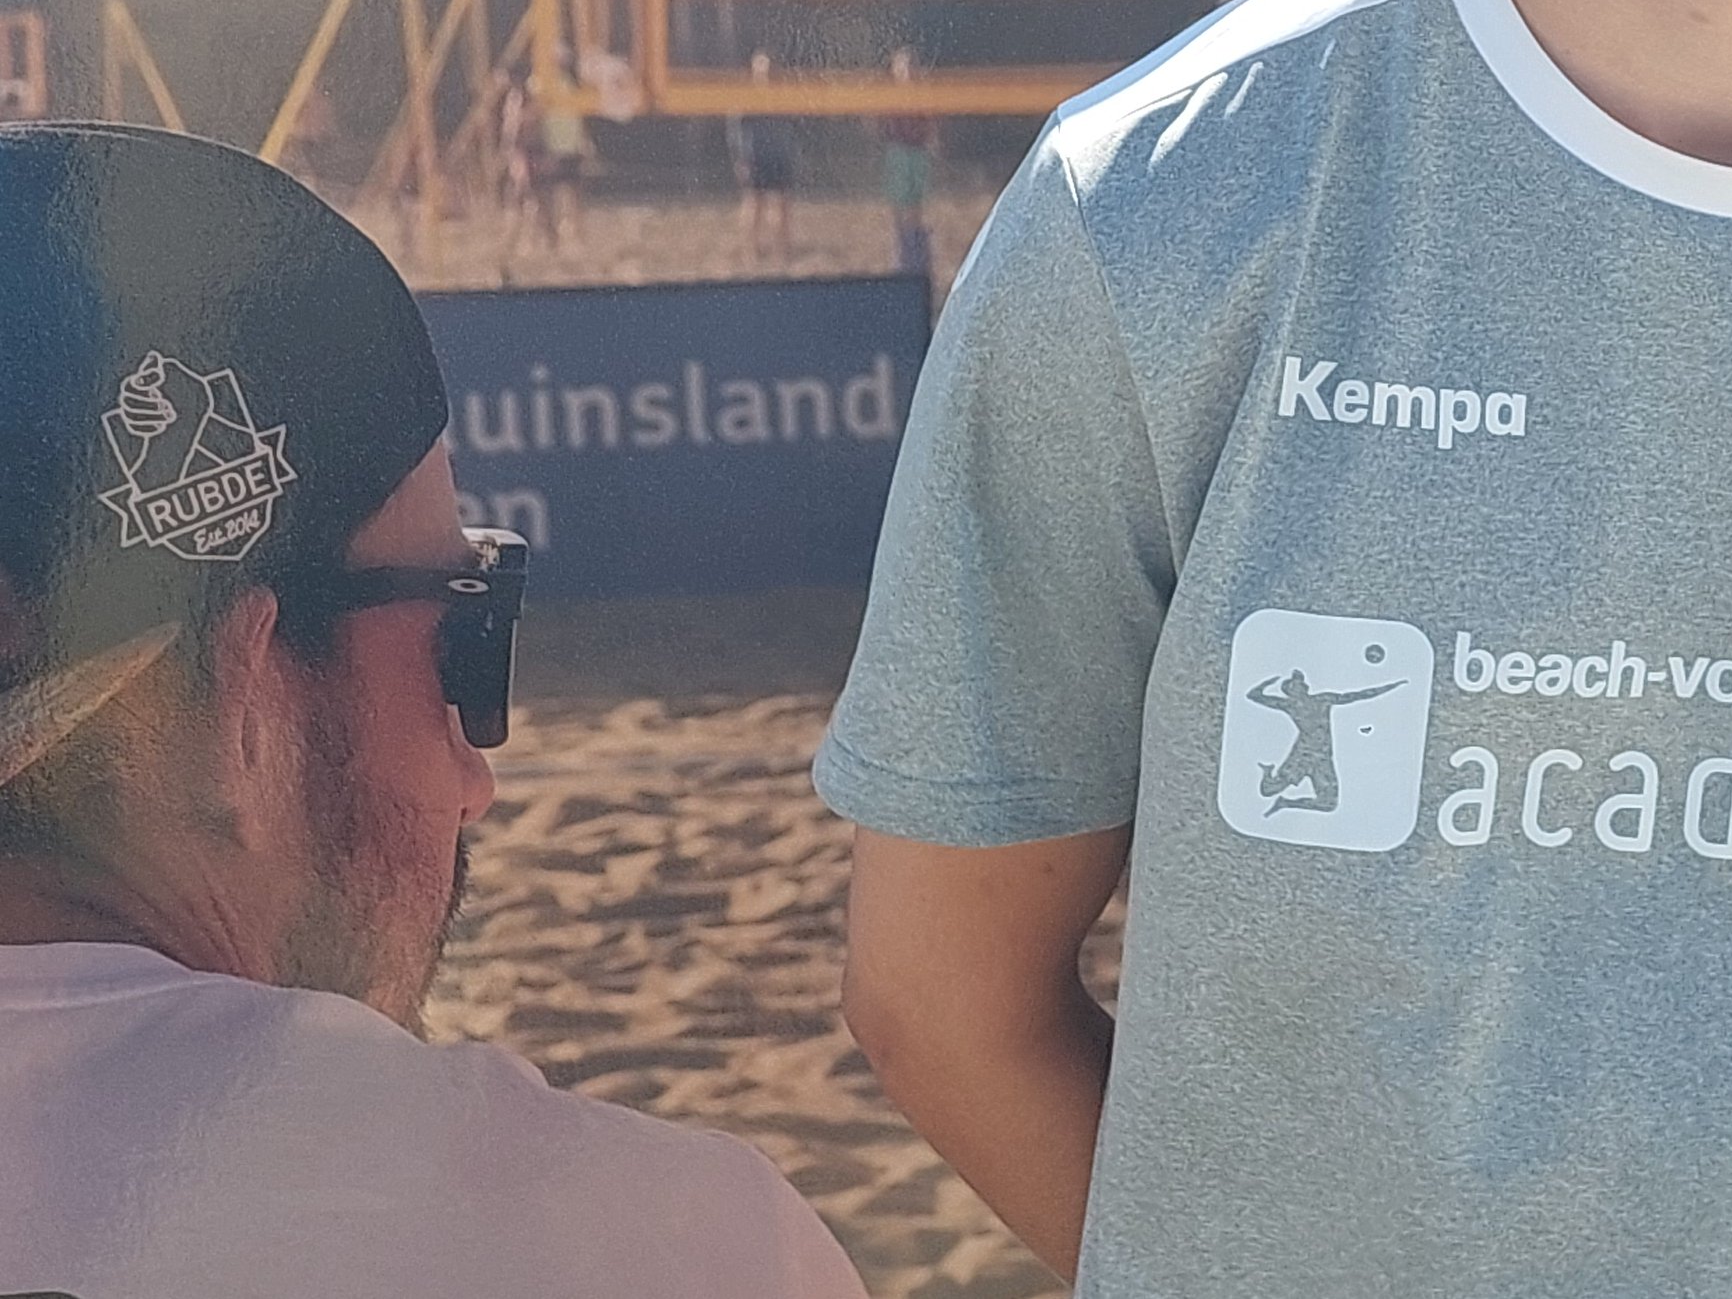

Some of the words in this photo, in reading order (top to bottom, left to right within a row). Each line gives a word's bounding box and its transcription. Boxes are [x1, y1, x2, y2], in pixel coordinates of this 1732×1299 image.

[447, 354, 896, 453] uinsland
[1278, 355, 1528, 449] Kempa
[147, 461, 272, 533] RUBDE
